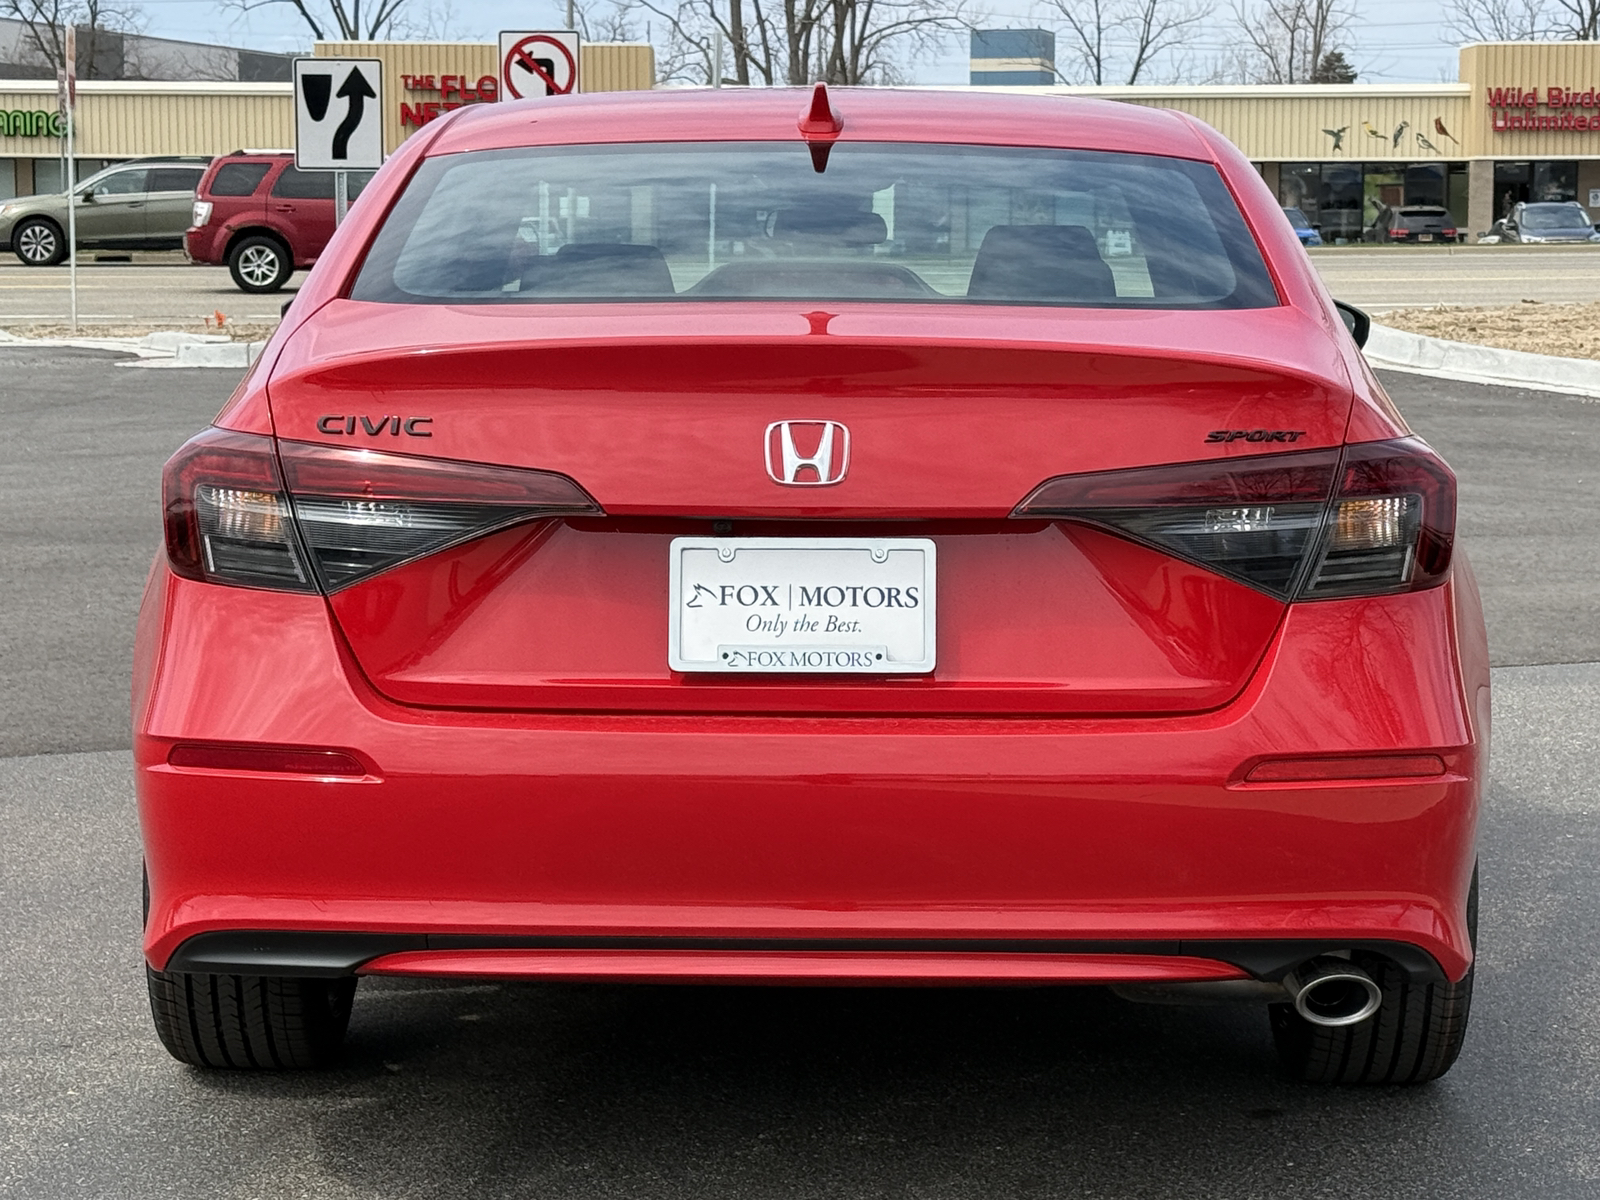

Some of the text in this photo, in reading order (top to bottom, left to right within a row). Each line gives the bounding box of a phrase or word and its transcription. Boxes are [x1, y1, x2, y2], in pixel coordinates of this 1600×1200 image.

[400, 75, 435, 90] THE
[1487, 87, 1537, 108] Wild
[317, 414, 433, 438] CIVIC
[1204, 430, 1307, 444] SPORT
[719, 585, 919, 609] FOX MOTORS
[746, 613, 862, 637] Only the Best.
[747, 652, 873, 667] FOX MOTORS
